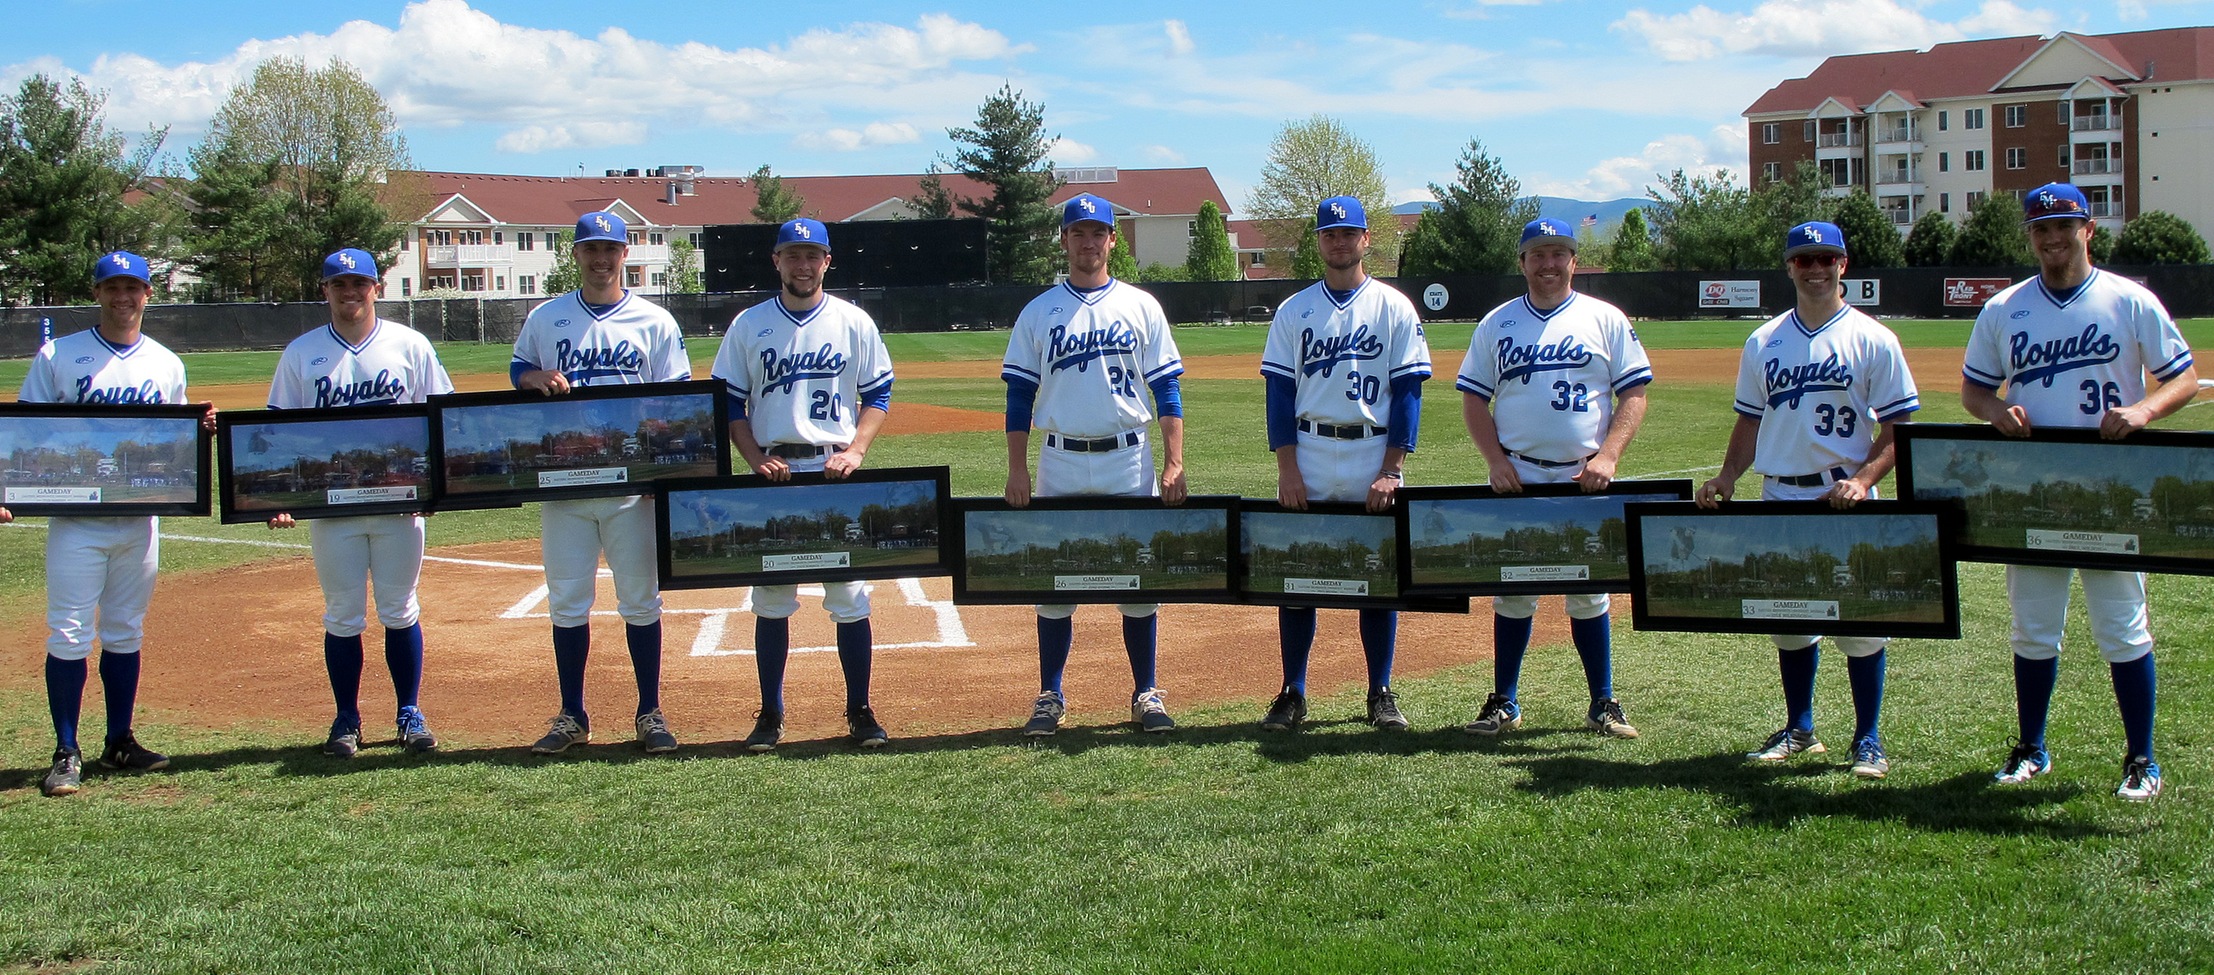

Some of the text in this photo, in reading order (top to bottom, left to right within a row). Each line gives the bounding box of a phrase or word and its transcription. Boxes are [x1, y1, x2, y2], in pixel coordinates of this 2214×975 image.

[1079, 198, 1095, 214] EMU
[1330, 202, 1346, 219] EMU
[596, 215, 611, 233] EMU
[795, 222, 810, 239] EMU
[1803, 226, 1821, 243] EMU
[113, 253, 130, 270] EMU
[339, 253, 356, 269] EMU
[1707, 285, 1724, 296] DQ
[1862, 281, 1874, 299] B
[1432, 297, 1441, 307] 14
[1047, 321, 1137, 373] Royals
[1301, 324, 1383, 378] Royals
[2010, 323, 2120, 388] Royals
[556, 339, 643, 385] Royals
[1497, 335, 1591, 385] Royals
[760, 343, 847, 395] Royals
[315, 369, 405, 408] Royals
[1345, 370, 1380, 406] 30
[1765, 354, 1853, 410] Royals
[1550, 380, 1589, 413] 32
[2080, 379, 2122, 415] 36
[810, 390, 842, 422] 20
[1814, 403, 1857, 438] 33
[540, 476, 551, 485] 25
[9, 492, 16, 501] 3
[329, 494, 340, 503] 19
[2028, 535, 2042, 546] 36
[2063, 532, 2103, 541] GAMEDAY
[764, 560, 775, 568] 20
[1056, 580, 1066, 588] 26
[1501, 571, 1513, 580] 32
[1284, 582, 1295, 591] 31
[1743, 605, 1755, 615] 33
